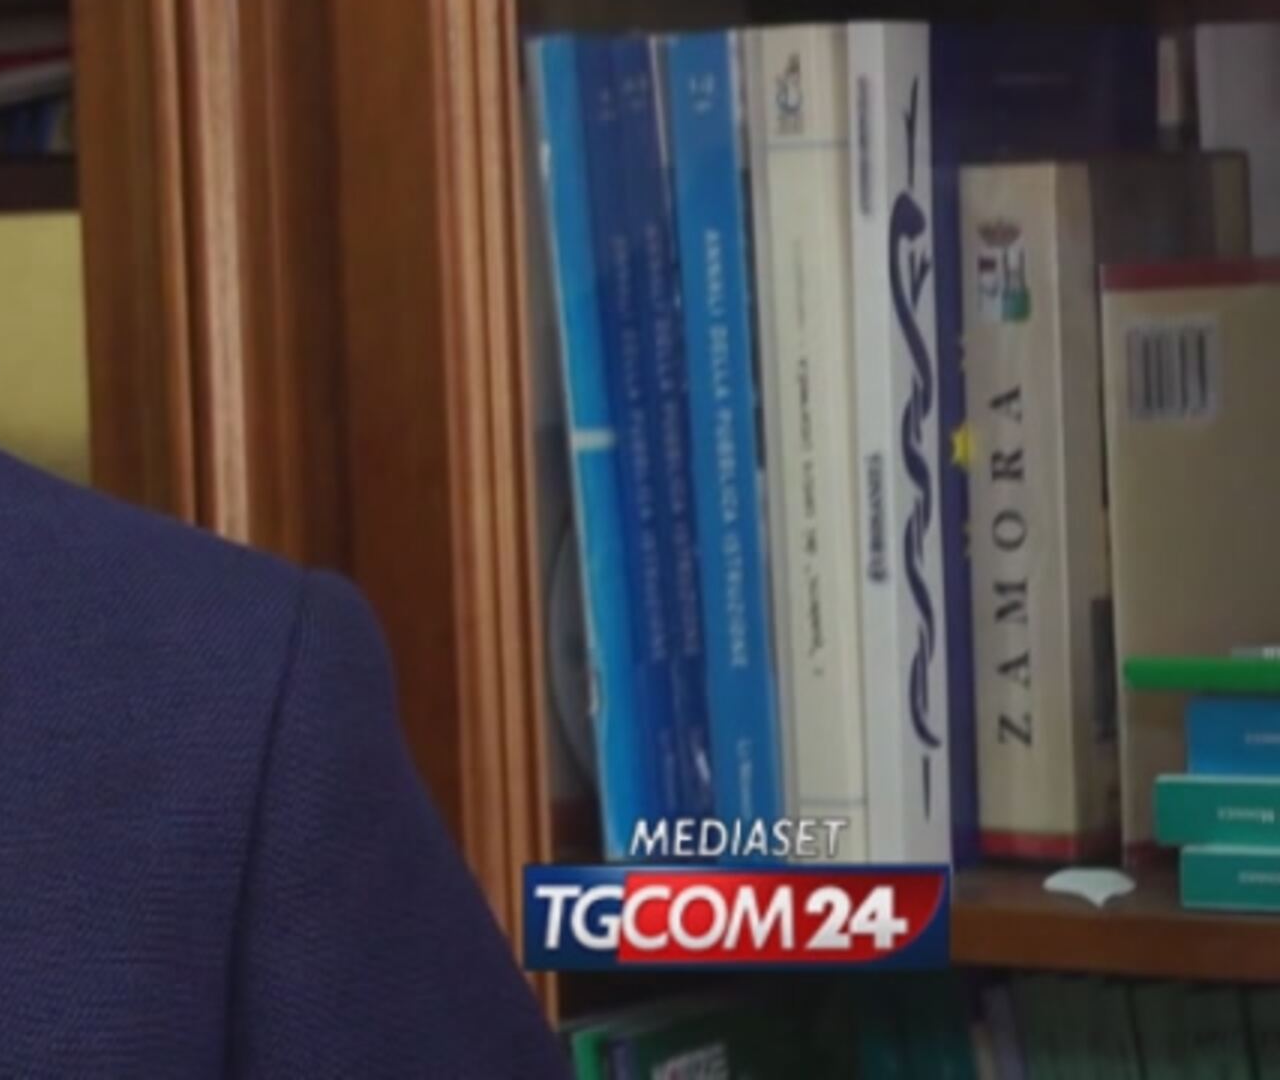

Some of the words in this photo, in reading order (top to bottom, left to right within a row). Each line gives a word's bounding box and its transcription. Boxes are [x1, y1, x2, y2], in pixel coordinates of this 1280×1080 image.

[704, 229, 725, 315] ANNALI
[709, 323, 730, 399] DELLA
[714, 408, 739, 524] PUBBLICA
[721, 533, 748, 670] ISTRUZIONE
[991, 384, 1031, 747] ZAMORA
